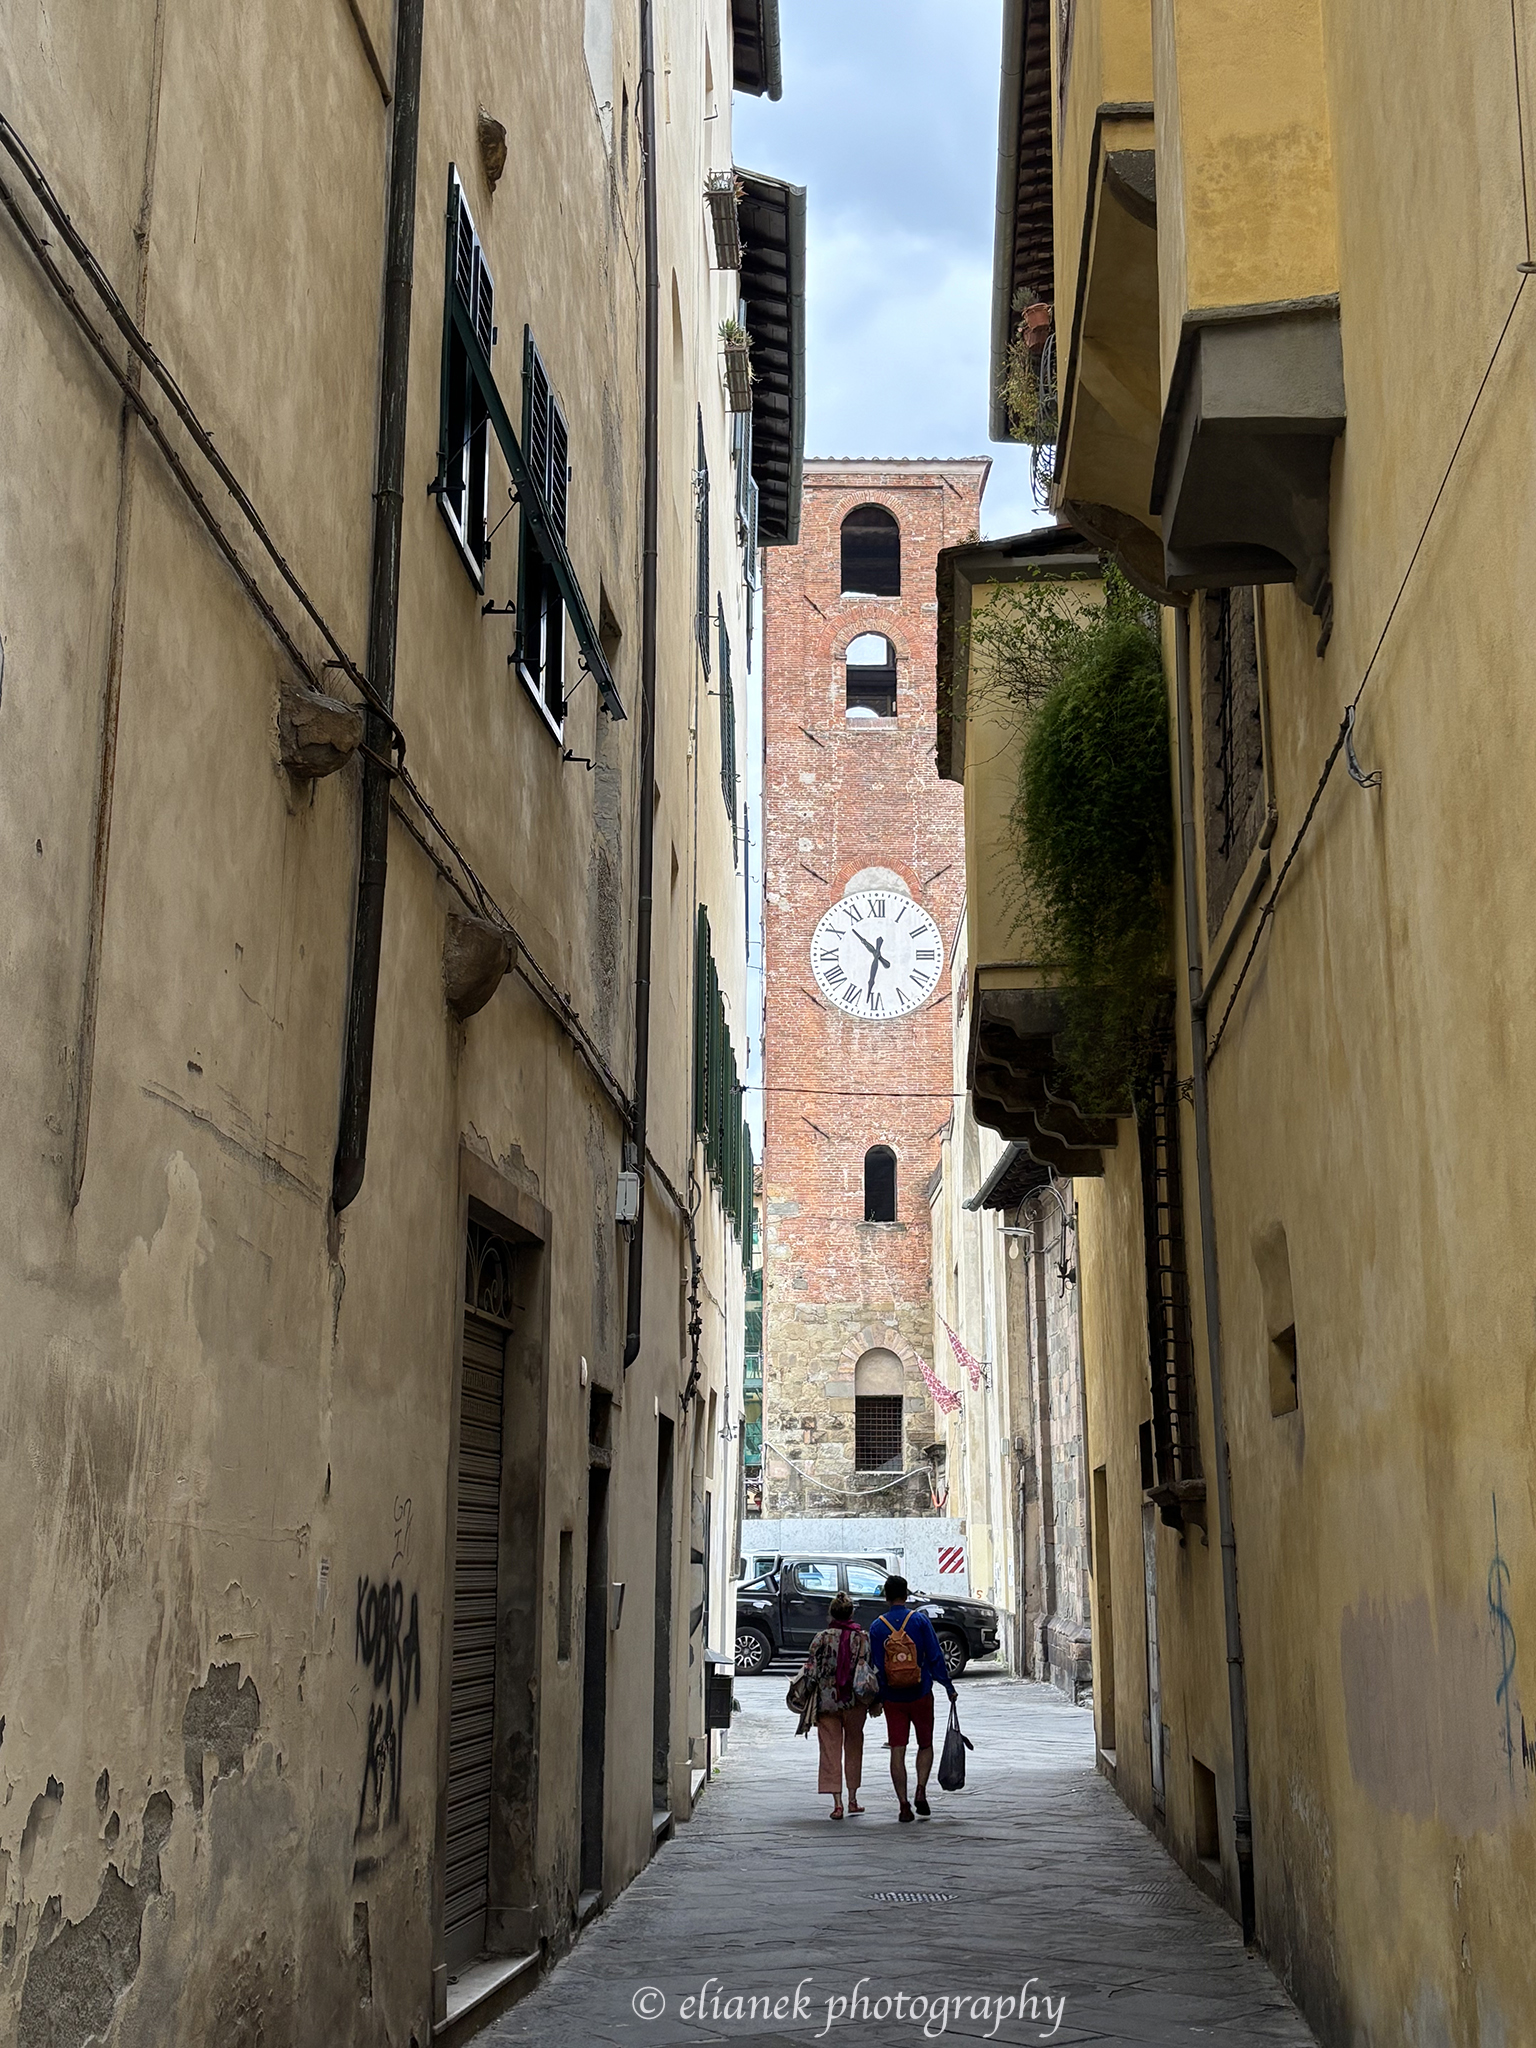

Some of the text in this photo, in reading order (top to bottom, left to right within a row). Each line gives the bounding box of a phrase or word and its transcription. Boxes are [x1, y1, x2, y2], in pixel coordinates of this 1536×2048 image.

[843, 903, 864, 926] XI
[867, 899, 886, 918] XII
[894, 906, 907, 923] I
[825, 922, 846, 941] X
[909, 924, 928, 939] II
[820, 947, 839, 962] IX
[915, 949, 935, 961] III
[823, 965, 848, 991] VIII
[909, 968, 930, 989] IV
[842, 983, 863, 1007] VII
[869, 992, 885, 1011] VI
[895, 987, 910, 1005] V
